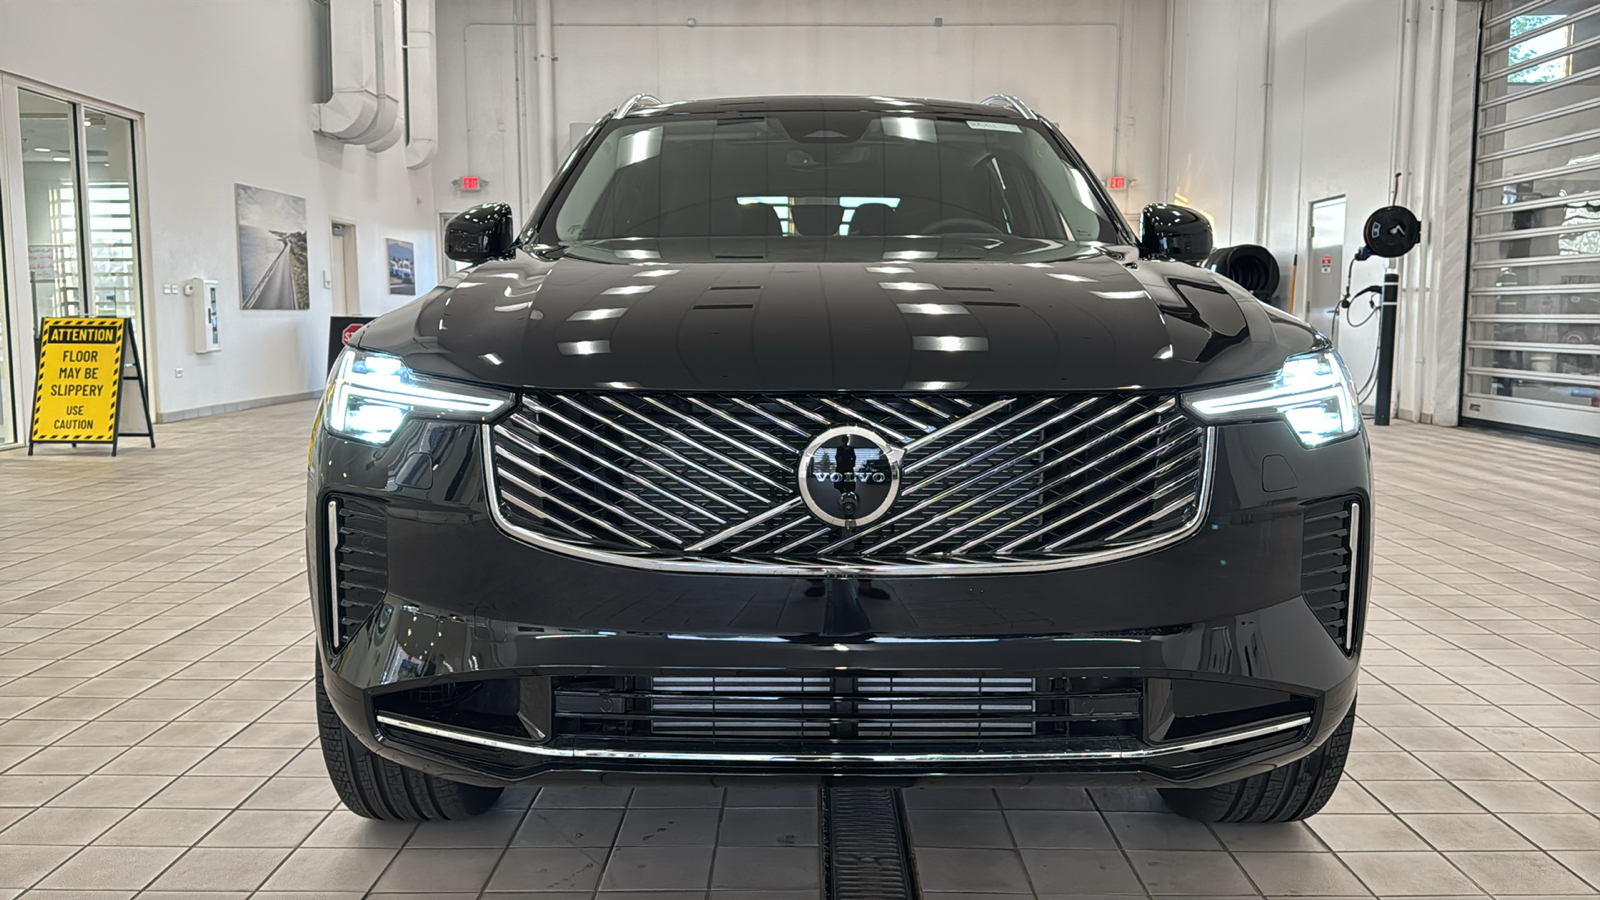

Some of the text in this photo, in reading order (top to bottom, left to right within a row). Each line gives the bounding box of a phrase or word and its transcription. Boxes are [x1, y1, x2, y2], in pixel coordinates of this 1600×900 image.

[463, 176, 478, 188] EXIT
[1110, 176, 1124, 188] EXIT
[50, 328, 114, 342] ATTENTION
[62, 350, 98, 363] FLOOR
[58, 367, 99, 380] MAY BE
[50, 384, 104, 397] SLIPPERY
[66, 405, 84, 416] USE
[53, 419, 94, 430] CAUTION
[813, 472, 886, 482] VOLVO
